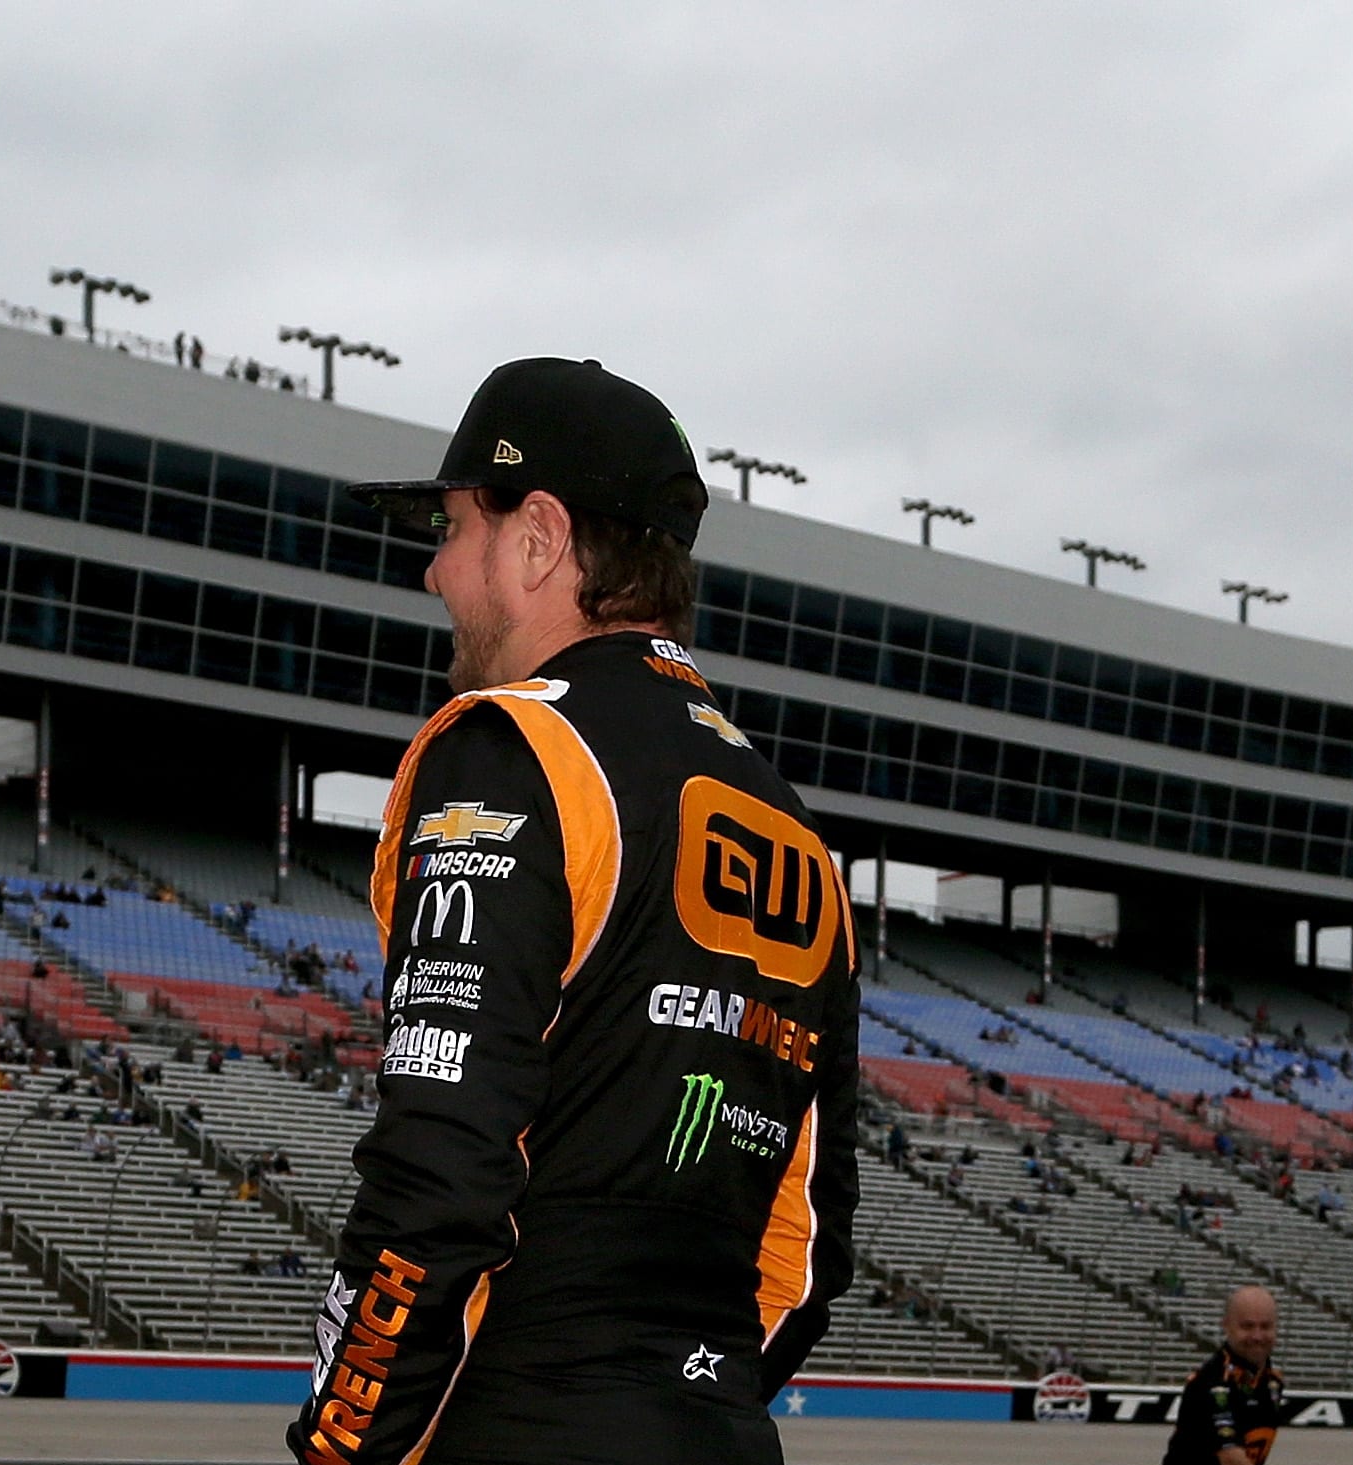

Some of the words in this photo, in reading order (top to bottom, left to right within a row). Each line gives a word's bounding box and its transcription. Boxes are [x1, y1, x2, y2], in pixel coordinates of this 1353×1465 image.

[651, 639, 698, 672] GEA
[424, 852, 517, 879] NASCAR
[413, 958, 485, 981] SHERWIN
[382, 1013, 472, 1064] Badger
[385, 1060, 459, 1078] SPORT
